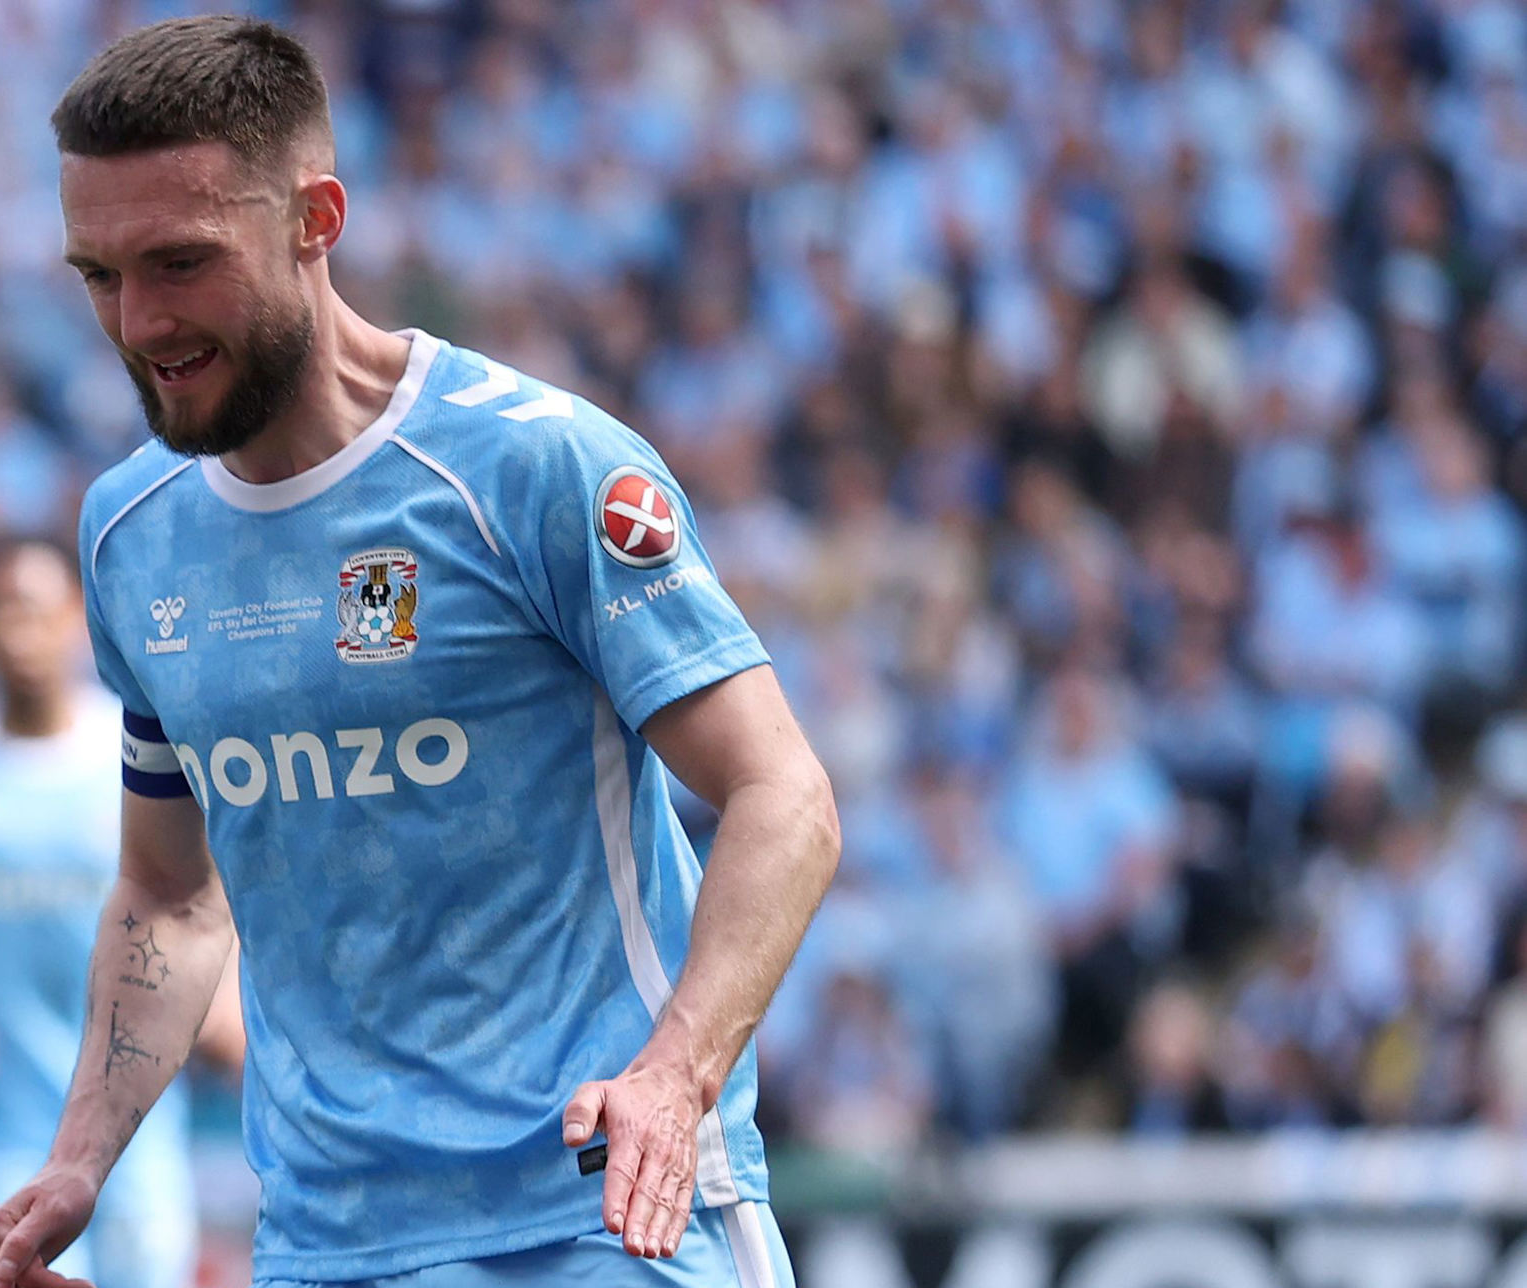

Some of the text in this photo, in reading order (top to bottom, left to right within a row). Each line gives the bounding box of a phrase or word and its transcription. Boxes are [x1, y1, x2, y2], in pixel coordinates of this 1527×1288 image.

[208, 596, 323, 620] Coventry City Football Club
[604, 595, 643, 621] XL
[207, 609, 322, 632] EFL Sky Bet Championship
[145, 634, 189, 655] hummel
[227, 626, 276, 641] Champions
